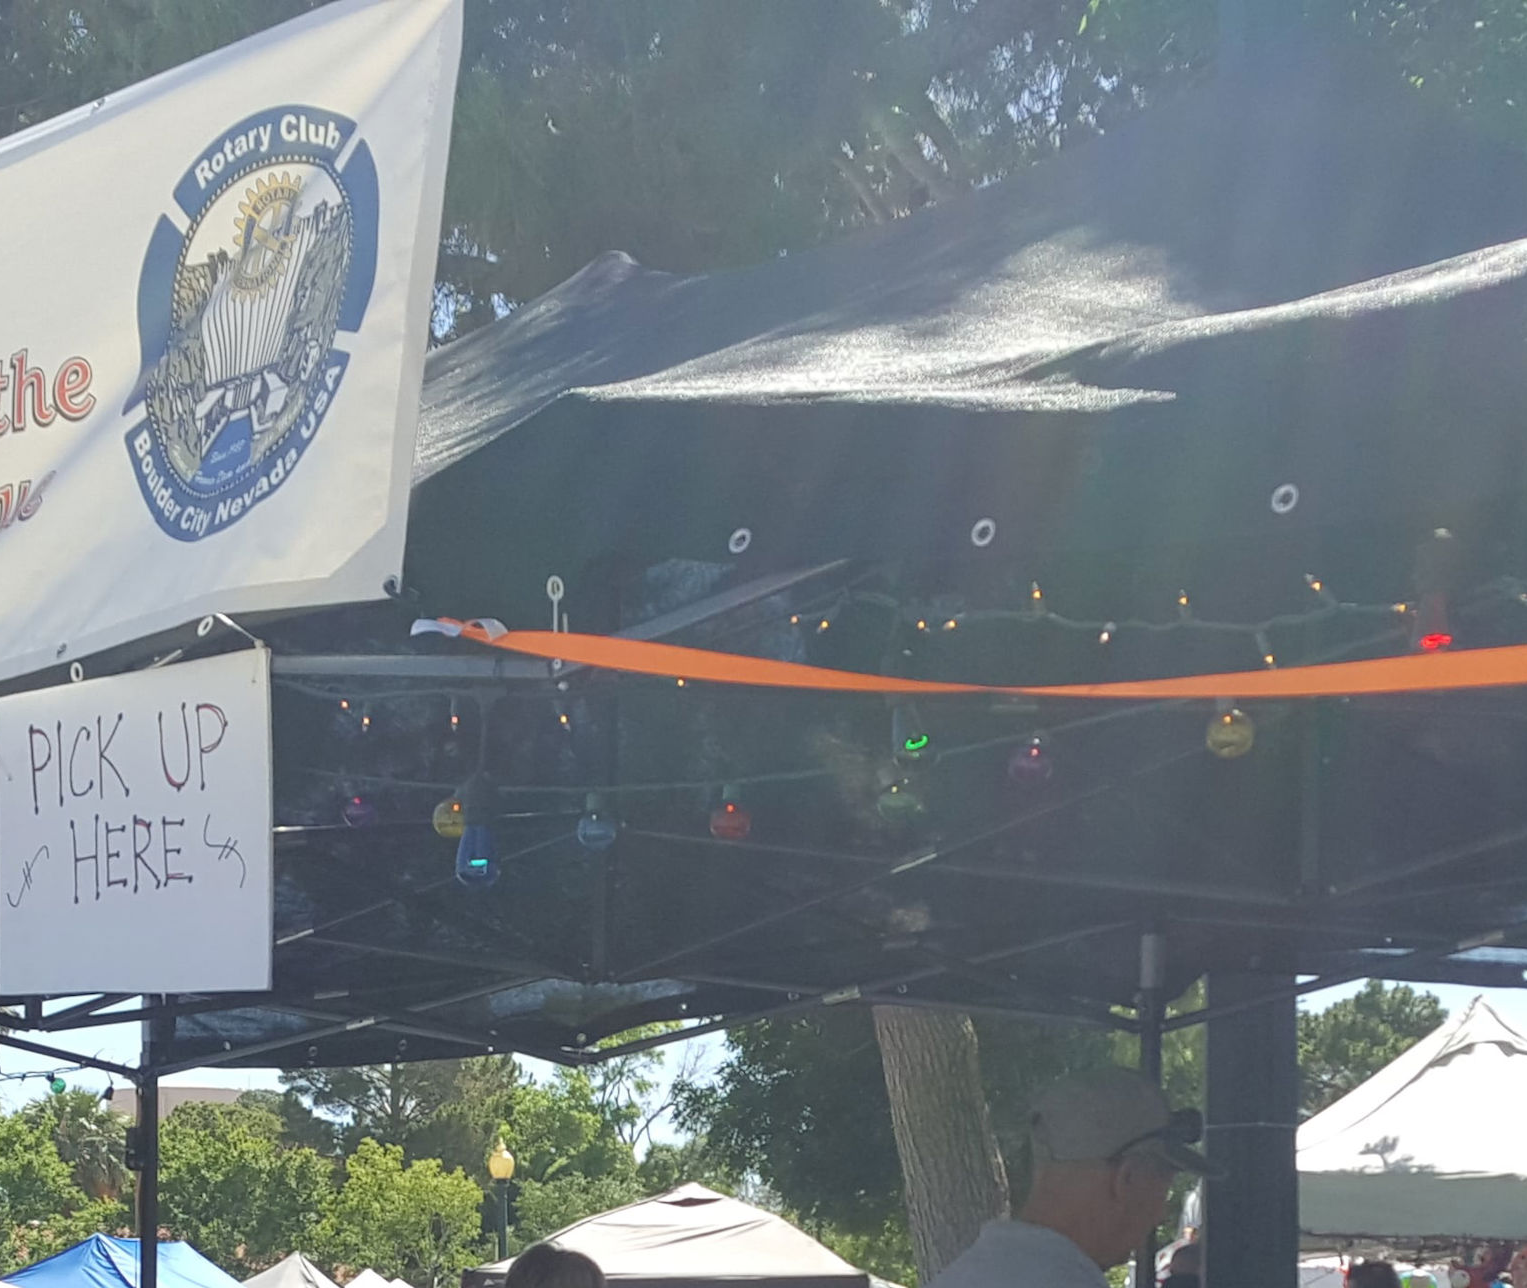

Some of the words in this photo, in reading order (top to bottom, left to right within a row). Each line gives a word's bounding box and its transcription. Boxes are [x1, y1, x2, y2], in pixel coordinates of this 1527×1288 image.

[193, 122, 272, 189] Rotary
[279, 114, 341, 150] Club
[133, 429, 183, 523] Boulder
[180, 504, 211, 537] City
[214, 448, 298, 525] Nevada
[300, 365, 342, 440] USA
[28, 712, 130, 815] PICK
[157, 702, 228, 792] UP
[70, 814, 194, 904] HERE
